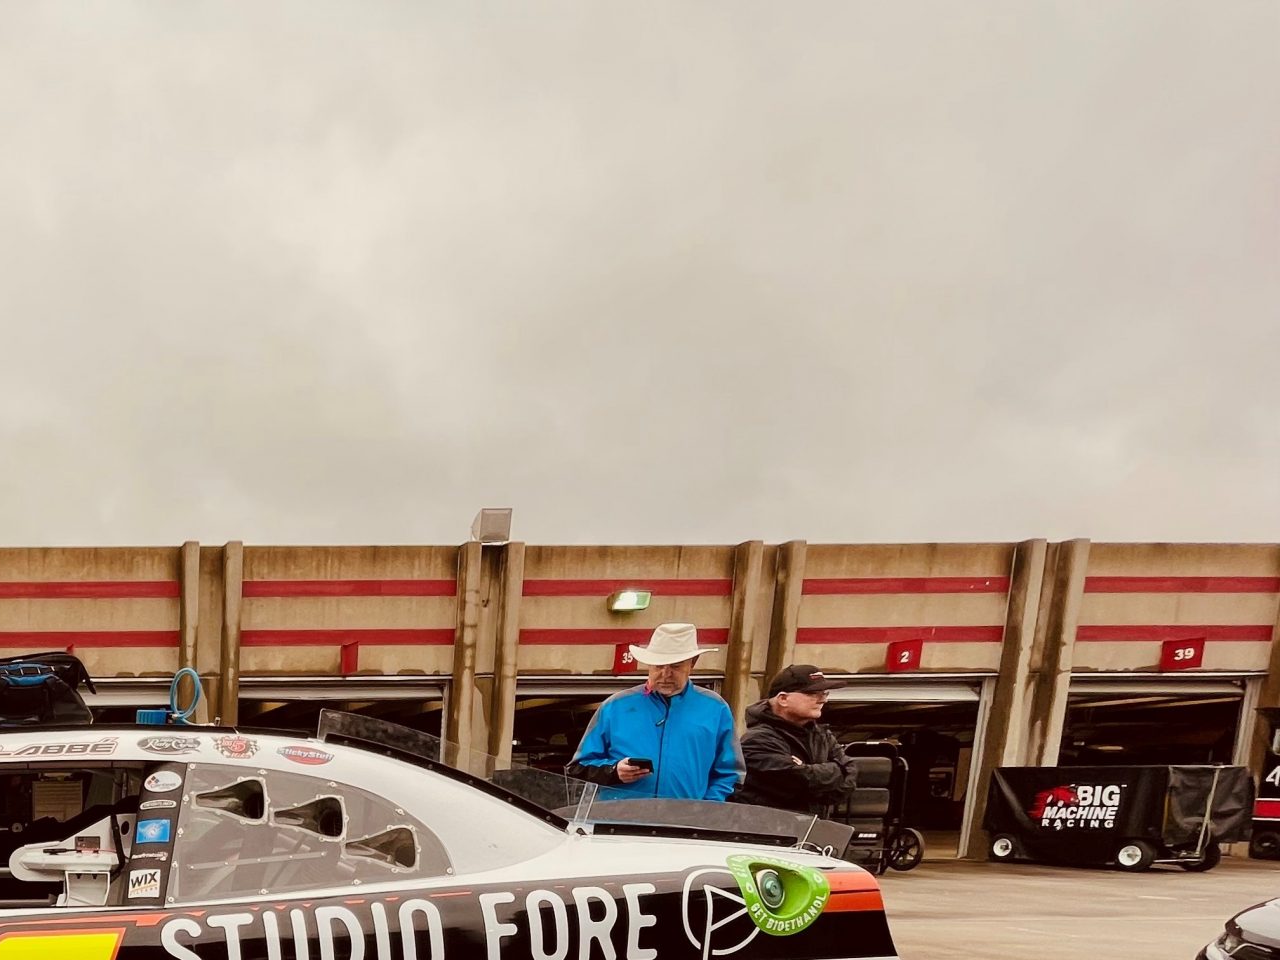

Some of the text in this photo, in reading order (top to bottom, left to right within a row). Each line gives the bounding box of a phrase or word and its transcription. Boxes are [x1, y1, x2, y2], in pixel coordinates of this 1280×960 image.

[900, 651, 910, 663] 2
[1173, 647, 1195, 661] 39
[1076, 785, 1120, 806] BIG
[1042, 806, 1118, 820] MACHINE
[1041, 819, 1114, 828] RACING
[131, 871, 158, 888] WIX
